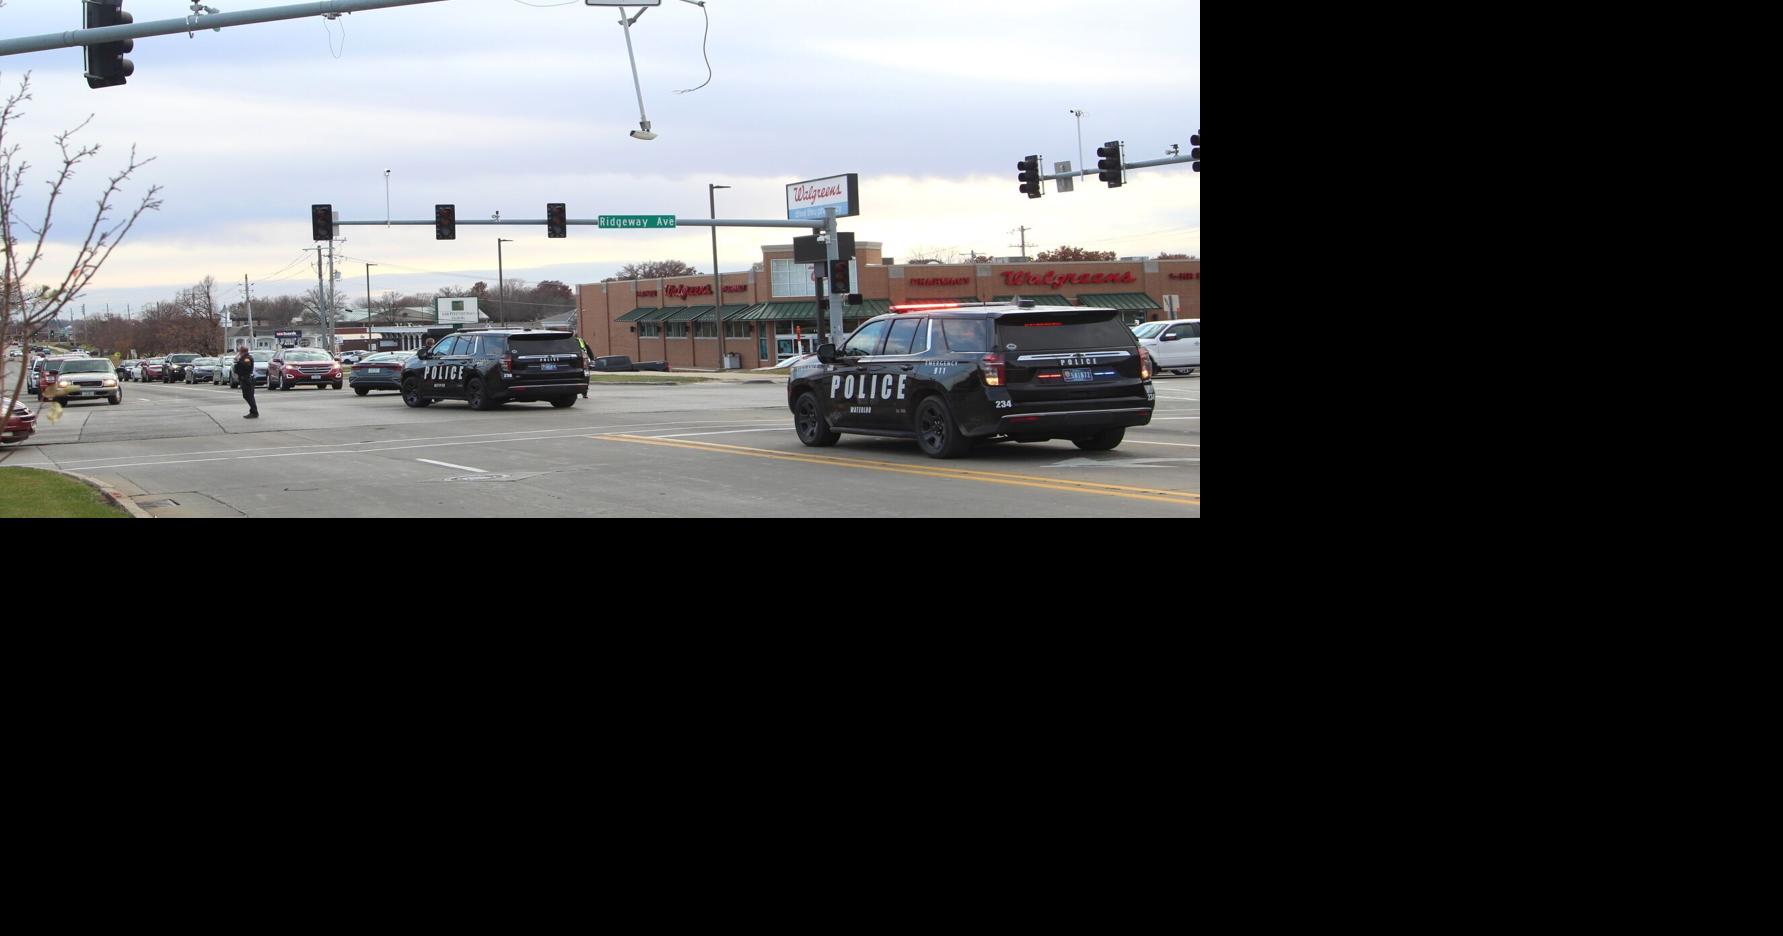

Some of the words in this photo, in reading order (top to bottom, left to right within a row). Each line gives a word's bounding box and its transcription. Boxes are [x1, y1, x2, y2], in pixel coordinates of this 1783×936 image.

[794, 184, 842, 205] Walgreens
[600, 216, 648, 227] Ridgeway
[656, 216, 674, 226] Ave
[1000, 270, 1137, 289] Walgreens
[1060, 358, 1097, 366] POLICE
[424, 366, 464, 380] POLICE
[830, 374, 908, 400] POLICE
[995, 400, 1012, 408] 234
